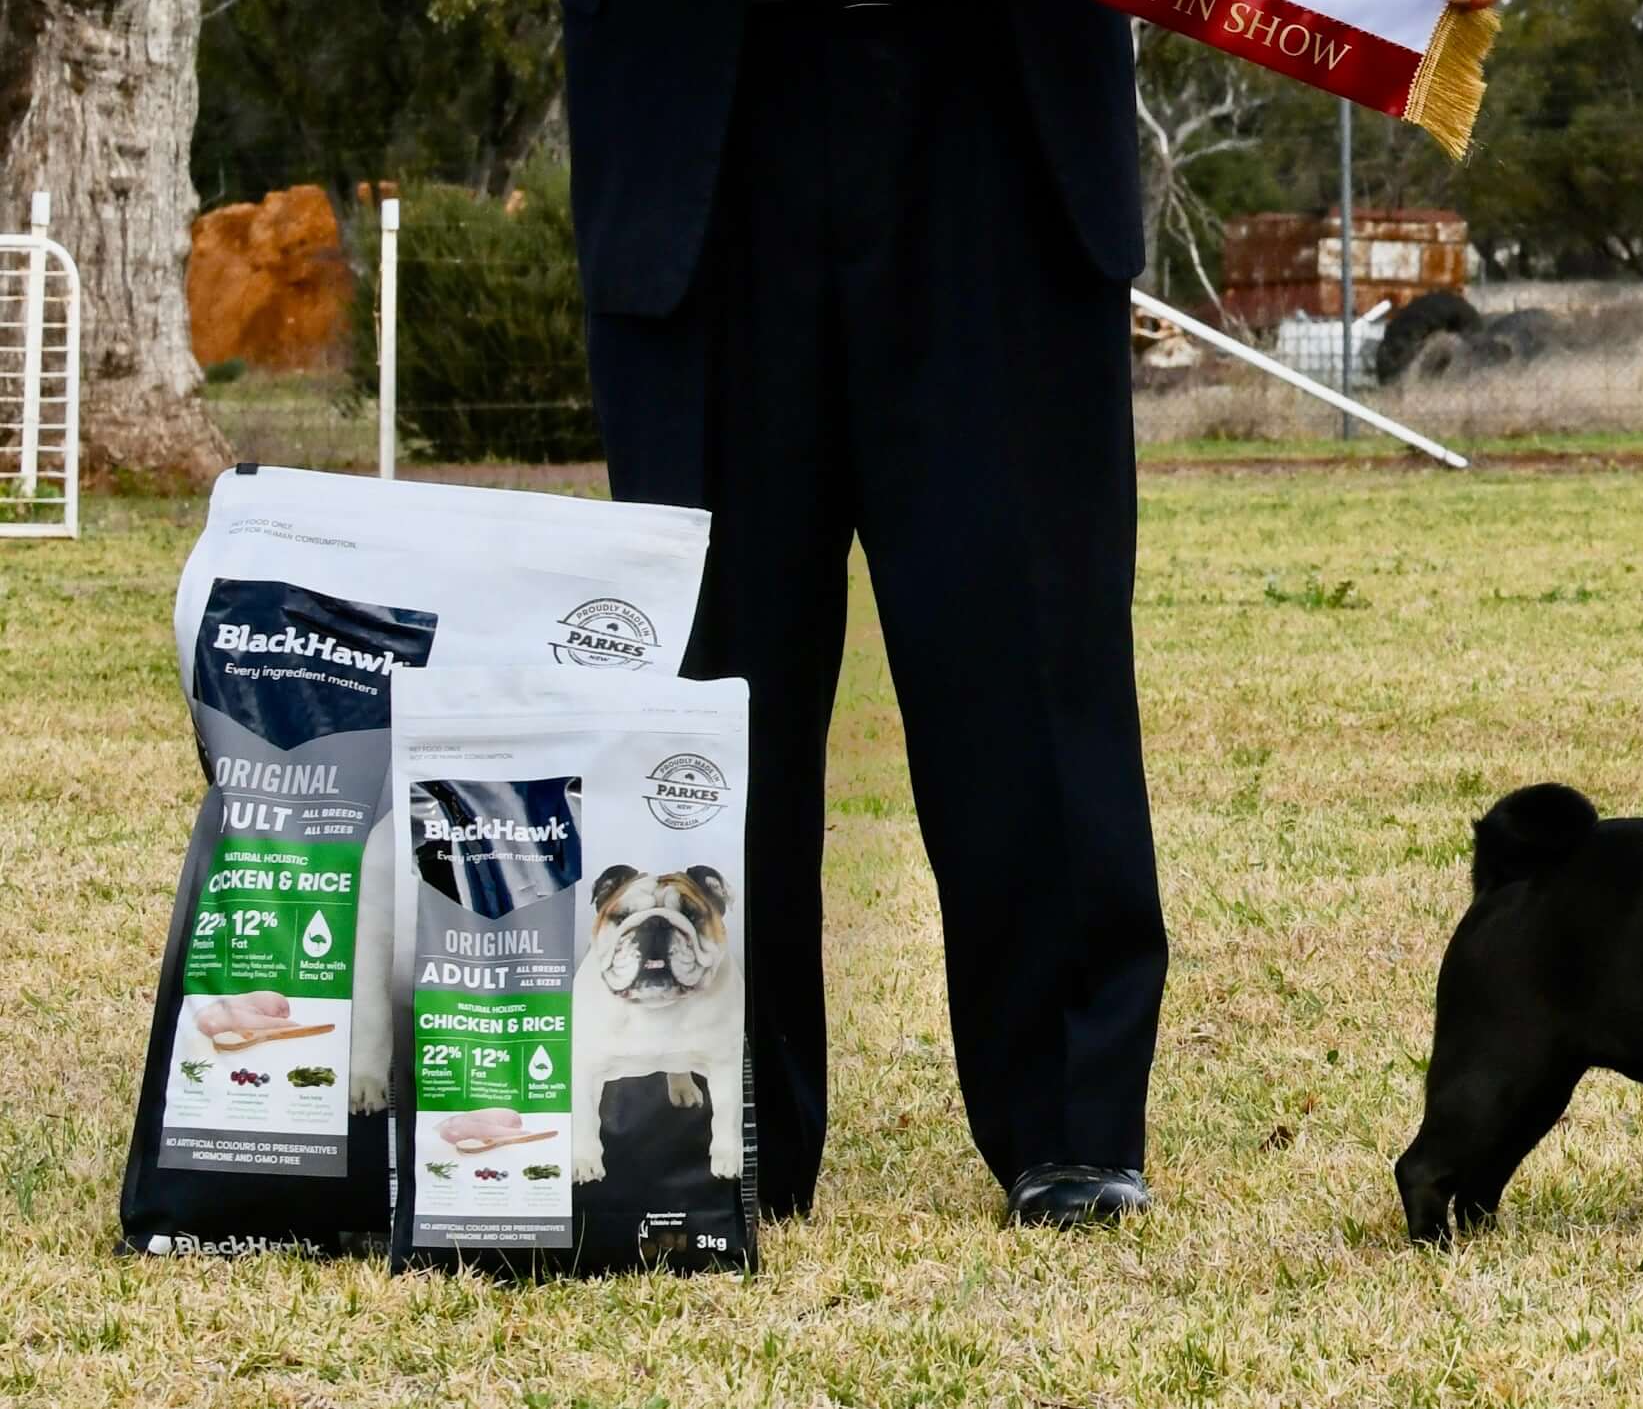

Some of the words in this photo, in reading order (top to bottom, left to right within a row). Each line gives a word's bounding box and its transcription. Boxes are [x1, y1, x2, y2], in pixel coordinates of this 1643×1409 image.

[1222, 1, 1354, 72] SHOW
[294, 534, 357, 549] CONSUMPTION
[576, 603, 620, 619] PROUDLY
[213, 623, 404, 676] BlackHawk
[566, 630, 647, 657] PARKES
[224, 662, 260, 680] Every
[262, 665, 326, 682] ingredient
[328, 674, 378, 695] matters
[215, 756, 340, 795] ORIGINAL
[656, 784, 719, 802] PARKES
[220, 801, 293, 833] ULT
[302, 809, 320, 819] ALL
[322, 808, 364, 820] BREEDS
[304, 825, 321, 835] ALL
[323, 825, 353, 835] SIZES
[423, 816, 569, 842] BlackHawk
[264, 853, 309, 866] HOLISTIC
[437, 850, 465, 864] Every
[466, 851, 514, 864] ingredient
[515, 852, 554, 862] matters
[278, 870, 292, 890] &
[297, 872, 352, 893] RICE
[231, 909, 278, 936] 12%
[231, 938, 248, 949] Fat
[445, 929, 544, 957] ORIGINAL
[300, 960, 324, 970] Made
[326, 960, 346, 971] with
[516, 965, 530, 973] ALL
[300, 971, 319, 981] Emu
[320, 971, 334, 981] Oil
[420, 961, 509, 989] ADULT
[457, 1002, 492, 1014] NATURAL
[492, 1004, 527, 1014] HOLISTIC
[420, 1013, 503, 1034] CHICKEN
[507, 1019, 518, 1033] &
[522, 1016, 565, 1032] RICE
[422, 1044, 462, 1065] 22%
[471, 1047, 510, 1068] 12%
[421, 1068, 452, 1078] Protein
[470, 1069, 487, 1079] Fat
[177, 1138, 214, 1149] ARTIFICIAL
[216, 1140, 256, 1152] COLOURS
[257, 1142, 271, 1152] OR
[272, 1143, 338, 1155] PRESERVATIVES
[192, 1151, 234, 1162] HORMONE
[235, 1153, 253, 1163] AND
[255, 1154, 278, 1164] GMO
[279, 1155, 301, 1165] FREE
[696, 1234, 727, 1251] 3kg
